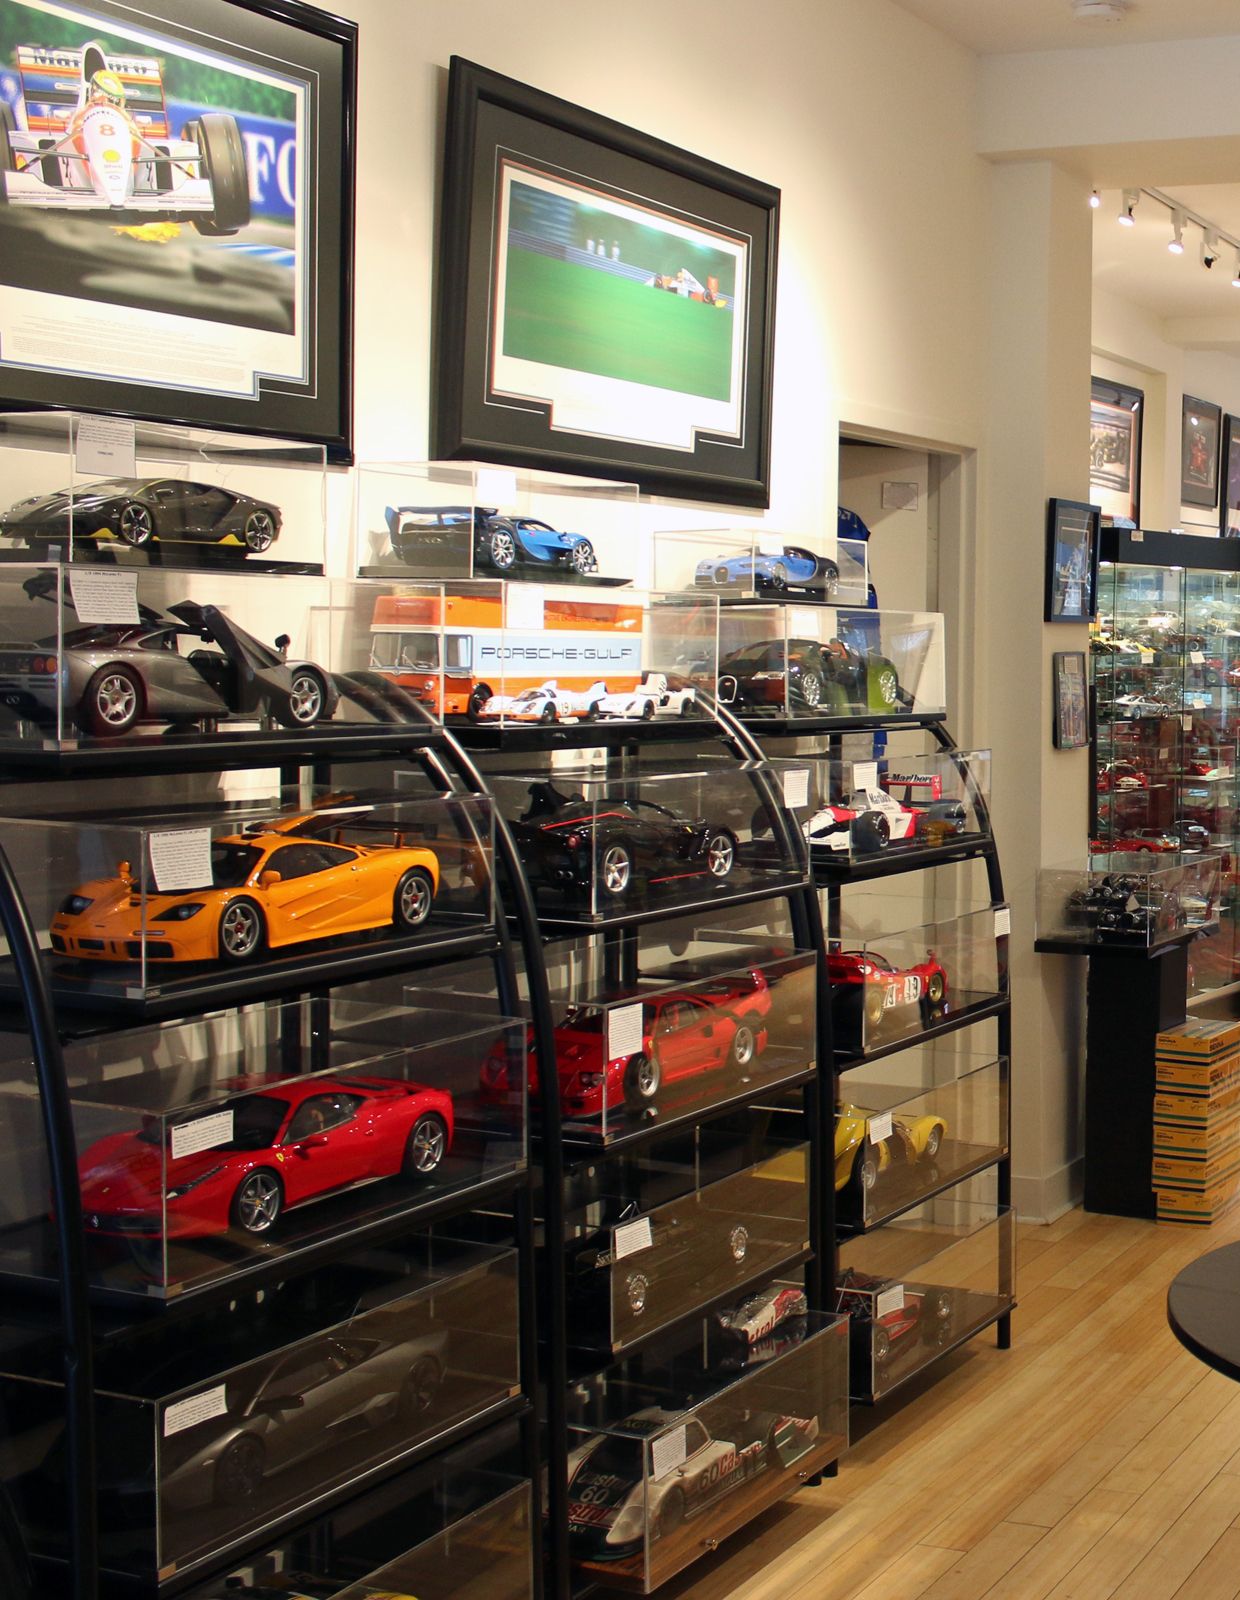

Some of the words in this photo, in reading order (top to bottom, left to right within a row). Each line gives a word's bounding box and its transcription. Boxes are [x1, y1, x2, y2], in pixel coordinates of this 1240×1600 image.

[480, 646, 633, 660] PORSCHE-GULF
[892, 773, 932, 783] Marlbor
[580, 1485, 611, 1505] 60
